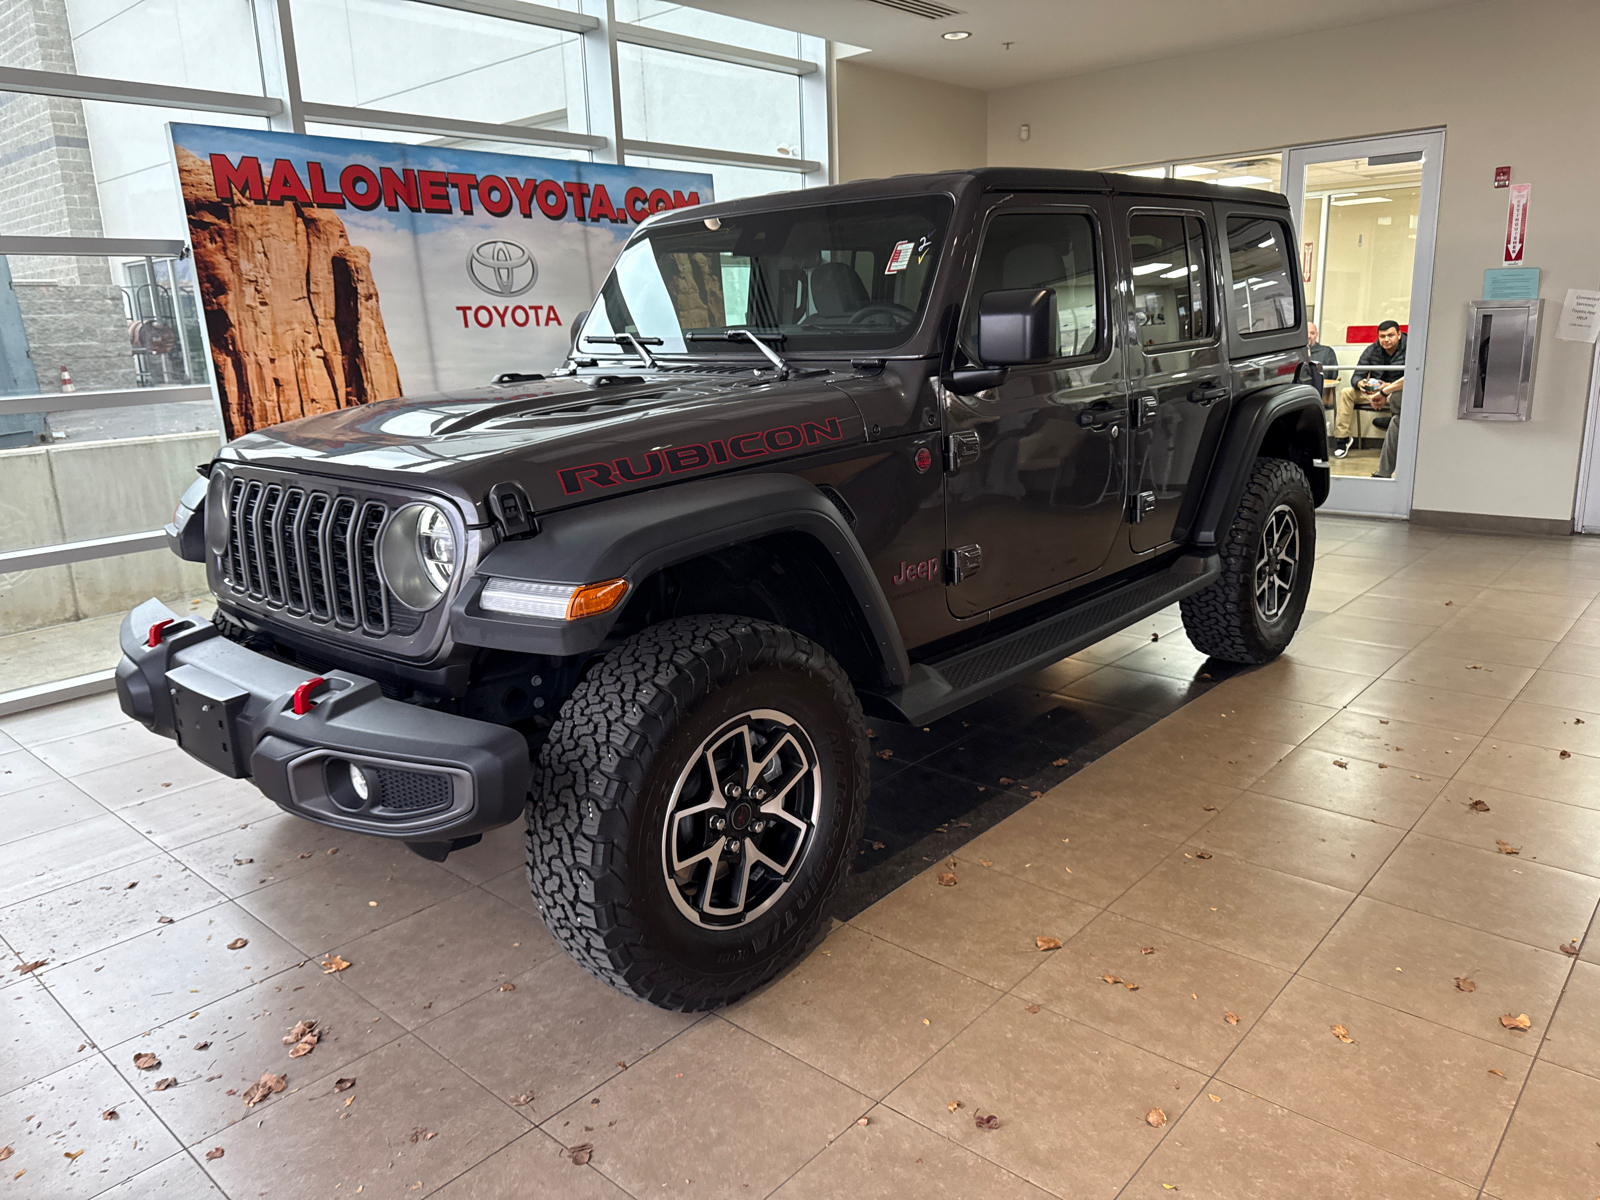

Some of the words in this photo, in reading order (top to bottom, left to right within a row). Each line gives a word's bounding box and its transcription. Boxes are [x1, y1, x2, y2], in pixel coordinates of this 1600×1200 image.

[209, 153, 701, 225] MALONETOYOTA.COM
[918, 236, 932, 252] 2
[1511, 199, 1521, 254] EXTINGUISHER
[456, 304, 562, 329] TOYOTA
[556, 416, 844, 496] RUBICON
[893, 557, 938, 585] Jeep
[796, 729, 848, 909] All-Terrain
